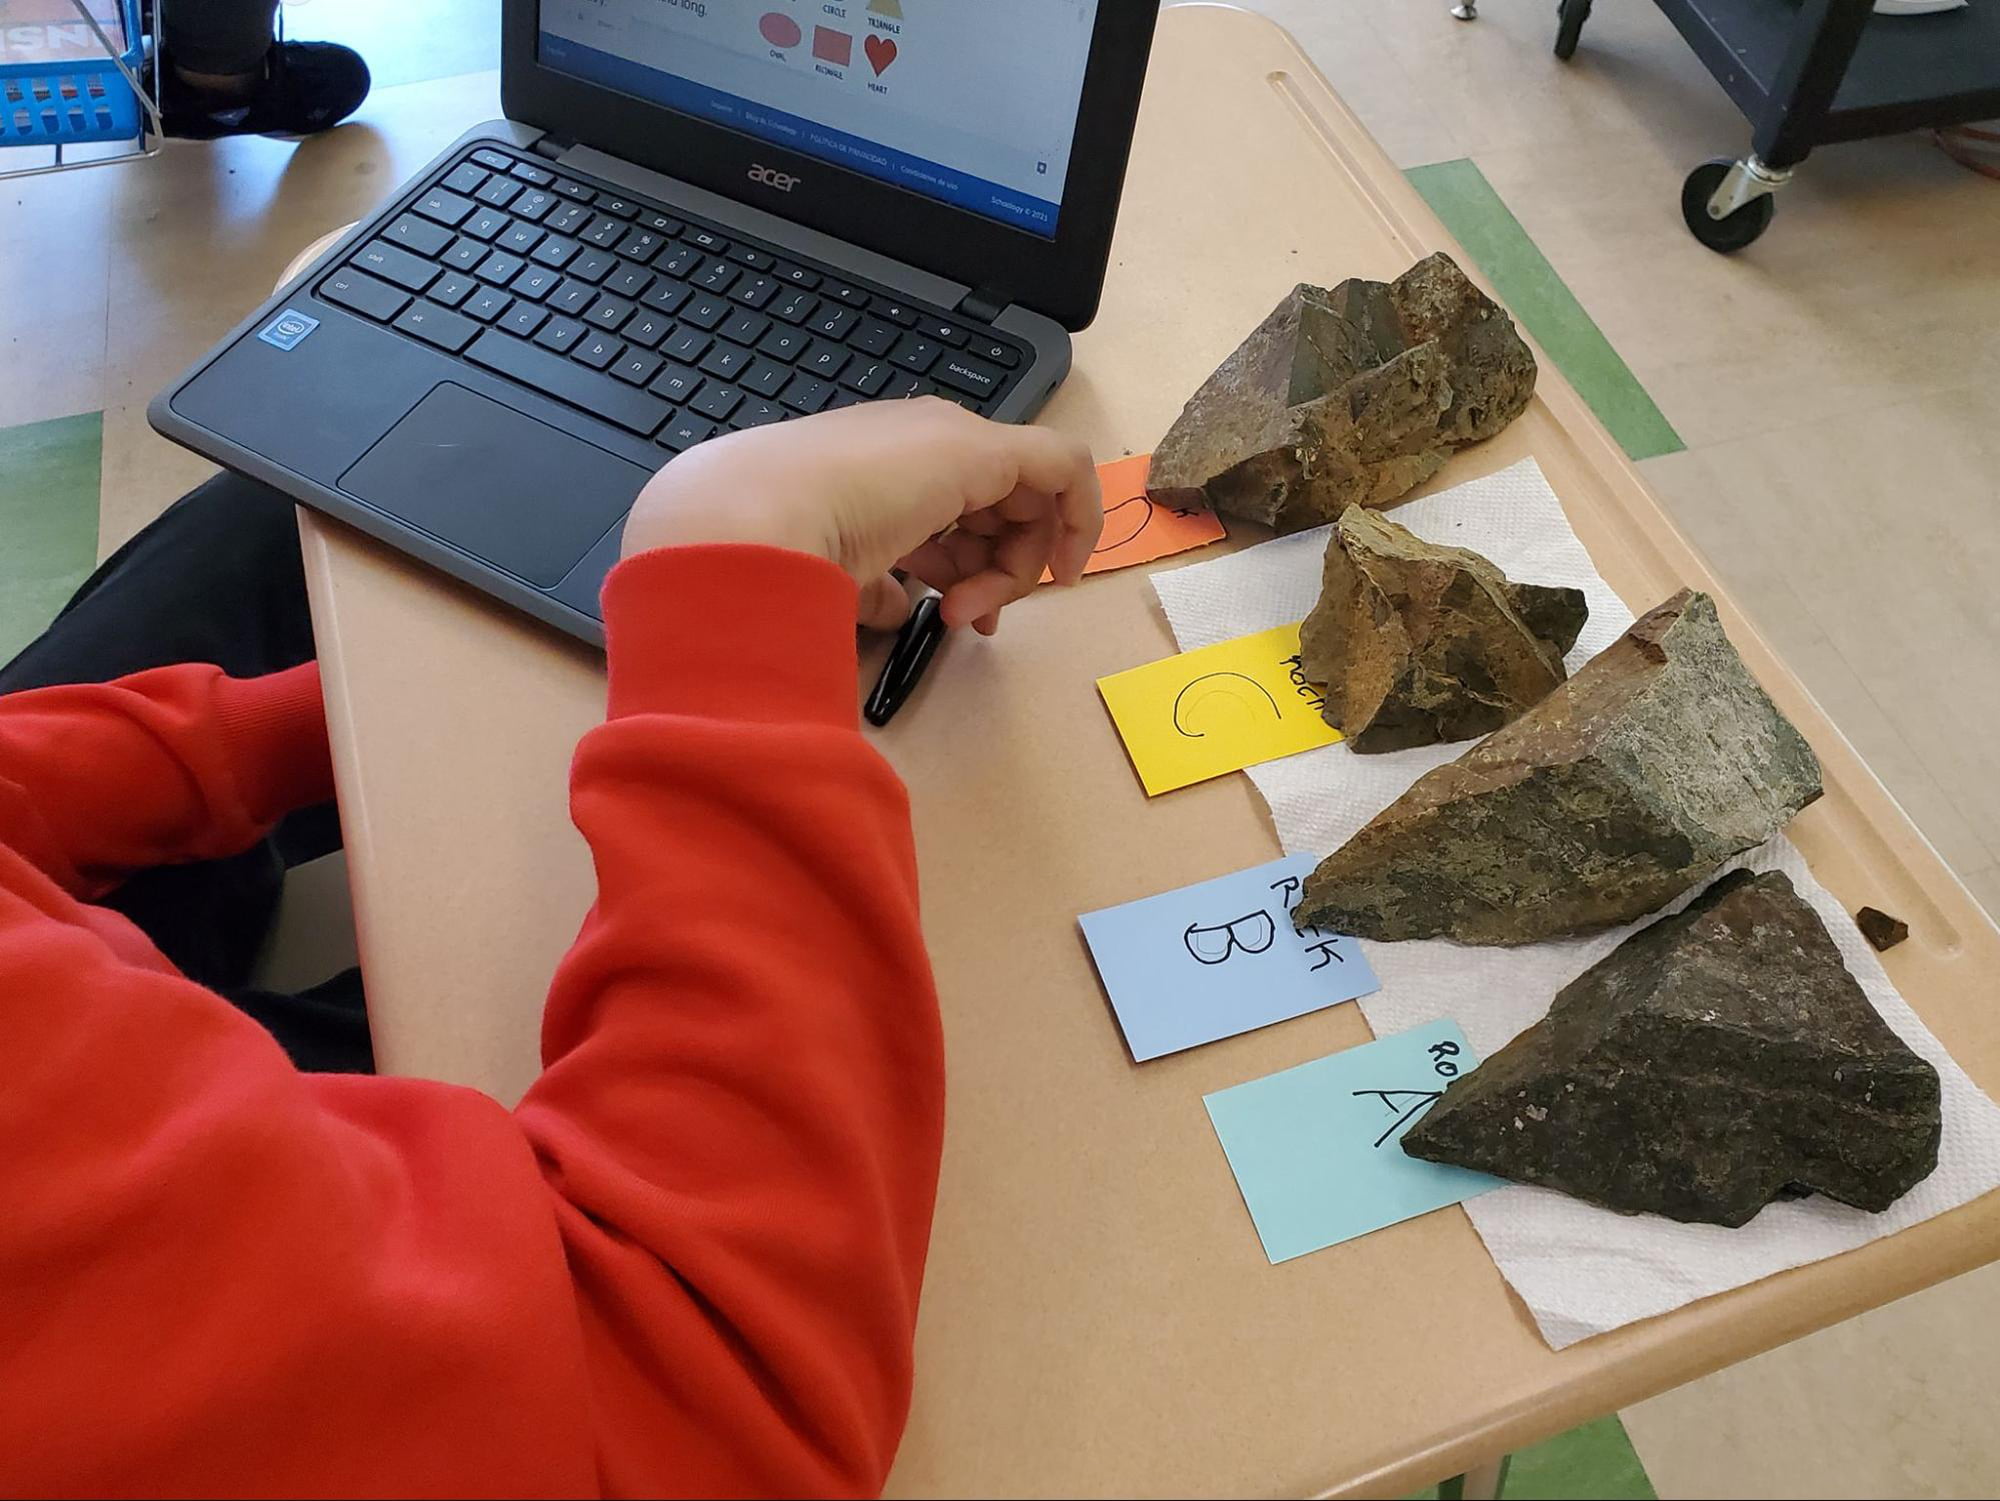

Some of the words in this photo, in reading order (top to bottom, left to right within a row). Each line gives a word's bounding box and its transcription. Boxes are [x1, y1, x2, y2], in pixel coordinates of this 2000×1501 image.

[822, 4, 846, 18] CIRCLE
[868, 17, 900, 34] TRIANGLE
[867, 82, 888, 95] HEART
[747, 163, 801, 192] acer
[482, 221, 490, 229] q
[558, 218, 568, 226] 3
[630, 246, 640, 254] 5
[532, 278, 542, 286] d
[568, 292, 578, 300] f
[660, 292, 672, 300] y
[603, 309, 614, 318] g
[784, 306, 793, 314] 9
[642, 323, 652, 332] h
[593, 344, 602, 353] b
[681, 340, 692, 349] j
[721, 355, 731, 364] k
[949, 363, 991, 385] backspace
[670, 379, 682, 388] m
[1174, 672, 1281, 738] C
[1184, 909, 1276, 965] B
[1353, 1090, 1444, 1147] A
